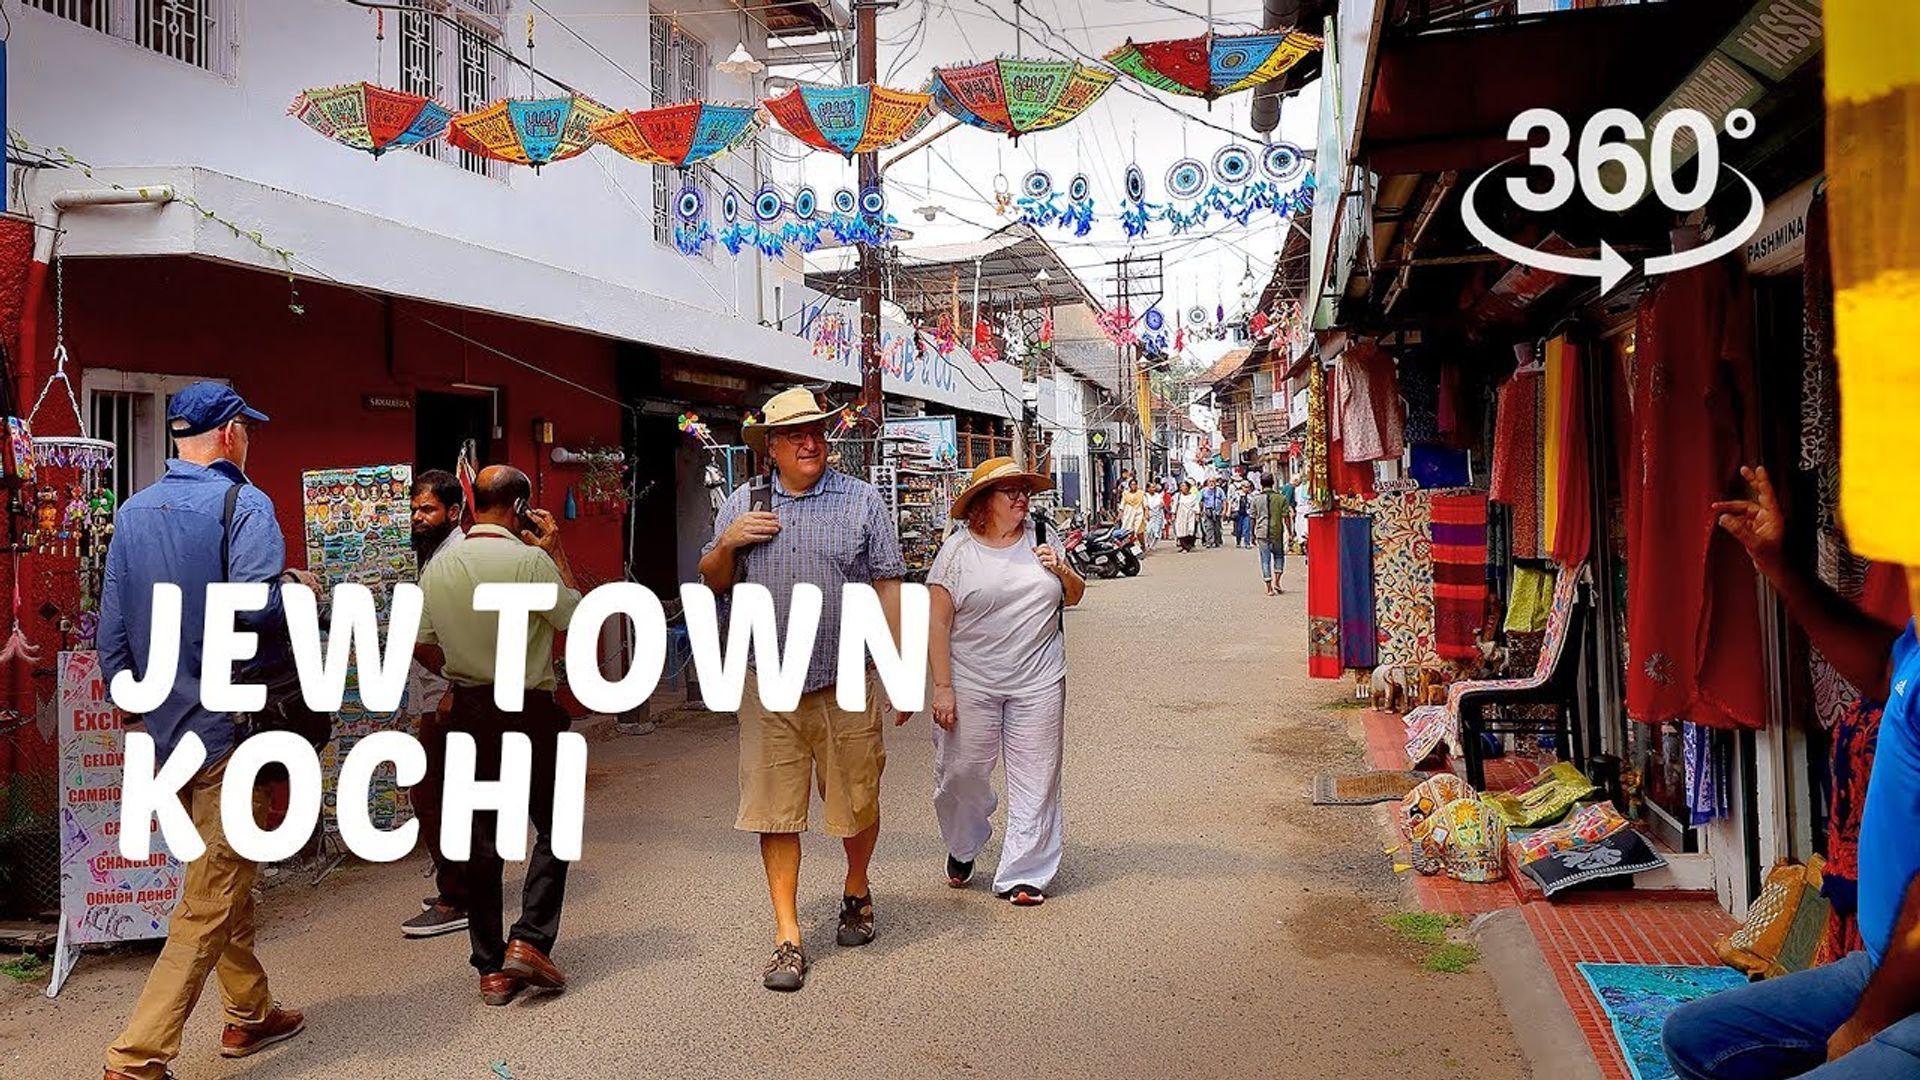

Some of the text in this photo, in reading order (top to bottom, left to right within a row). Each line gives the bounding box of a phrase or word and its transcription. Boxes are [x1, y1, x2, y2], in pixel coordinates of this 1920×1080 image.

[1747, 216, 1804, 264] PASHMINA
[68, 787, 122, 803] CAMBIO
[86, 887, 178, 906] Обмен денег
